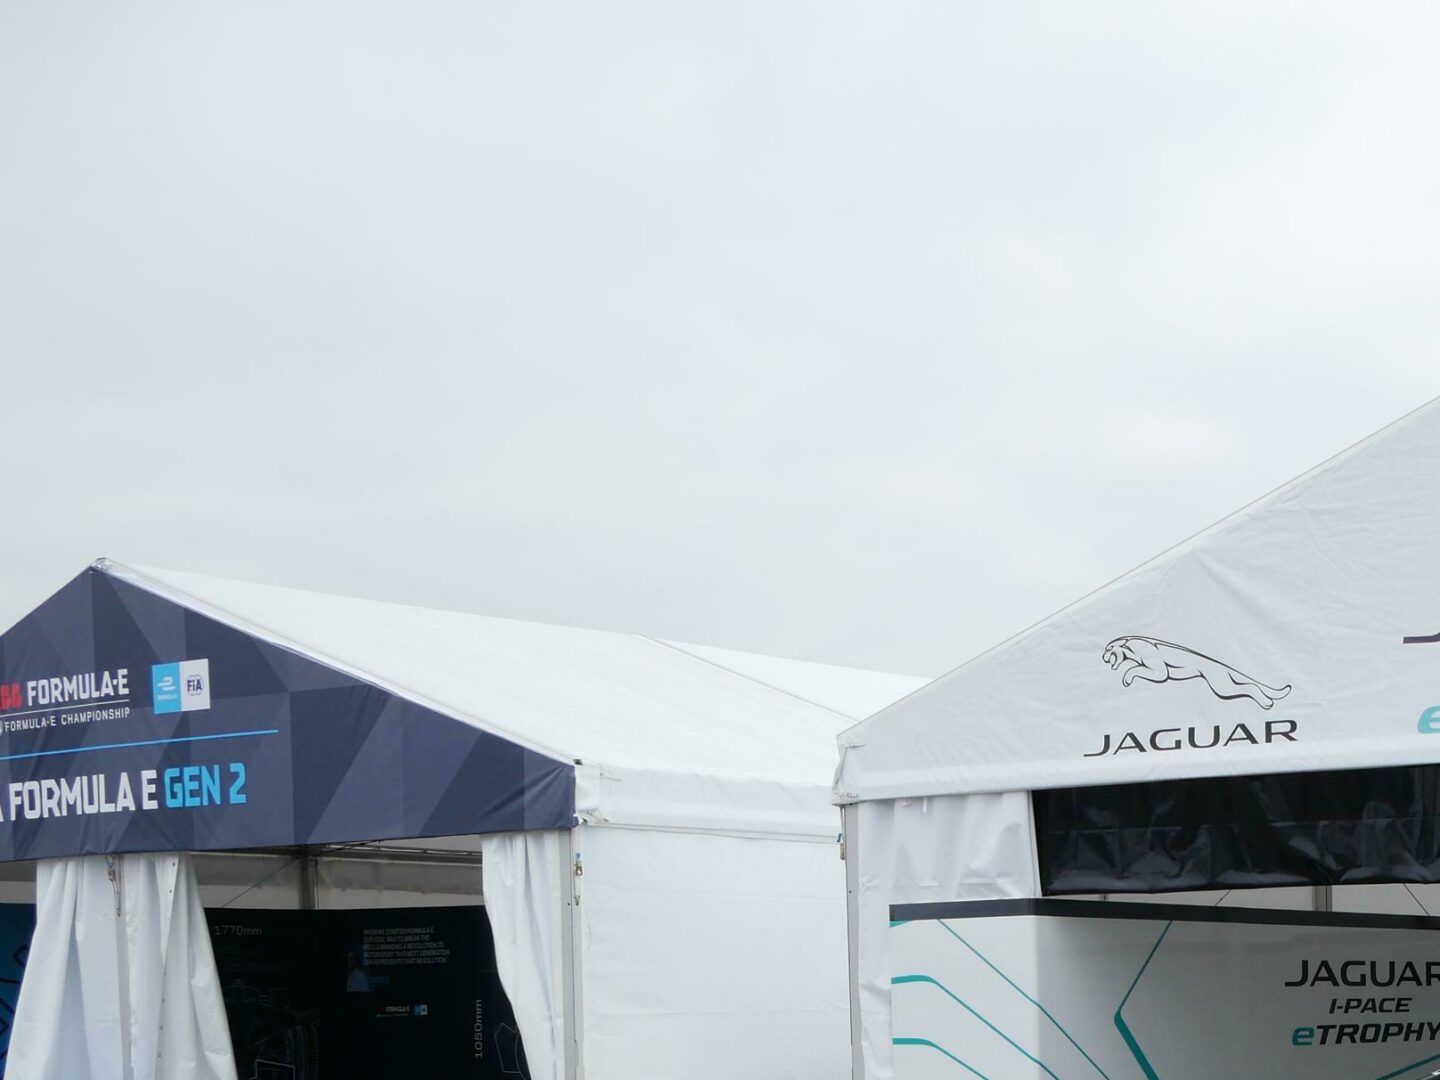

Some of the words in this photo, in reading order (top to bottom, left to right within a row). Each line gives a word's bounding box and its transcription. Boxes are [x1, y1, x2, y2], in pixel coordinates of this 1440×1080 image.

[0, 683, 23, 709] BB
[61, 707, 131, 726] CHAMPIONSHIP
[1083, 719, 1298, 757] JAGUAR
[8, 772, 136, 822] FORMULA
[141, 769, 158, 810] E
[164, 764, 221, 809] GEN
[230, 762, 247, 804] 2
[1328, 997, 1413, 1015] I-PACE
